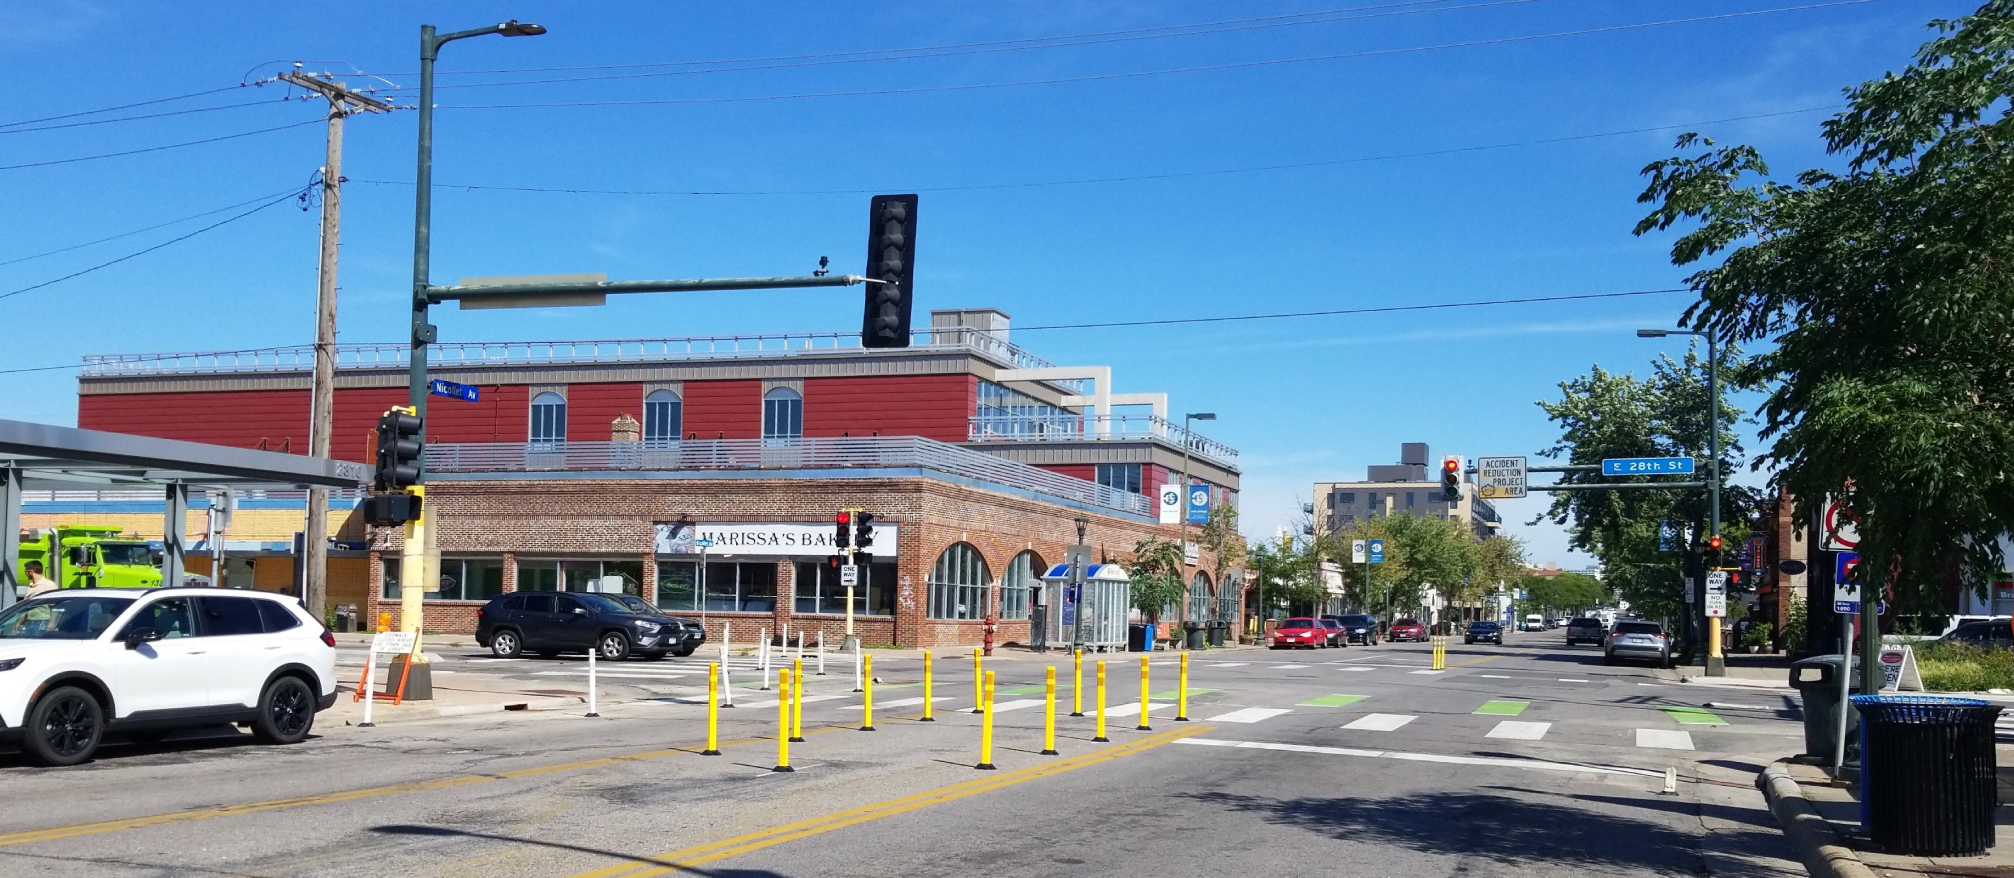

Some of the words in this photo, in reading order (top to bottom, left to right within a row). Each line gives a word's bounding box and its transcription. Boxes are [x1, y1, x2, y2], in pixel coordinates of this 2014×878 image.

[436, 382, 462, 396] Nicollet
[1486, 460, 1519, 468] ACCIDENT
[1613, 463, 1622, 471] E
[1629, 462, 1661, 471] 28th
[1668, 461, 1683, 470] St
[1483, 469, 1521, 477] REDUCTION
[1493, 478, 1523, 486] PROJECT
[1504, 487, 1524, 495] AREA
